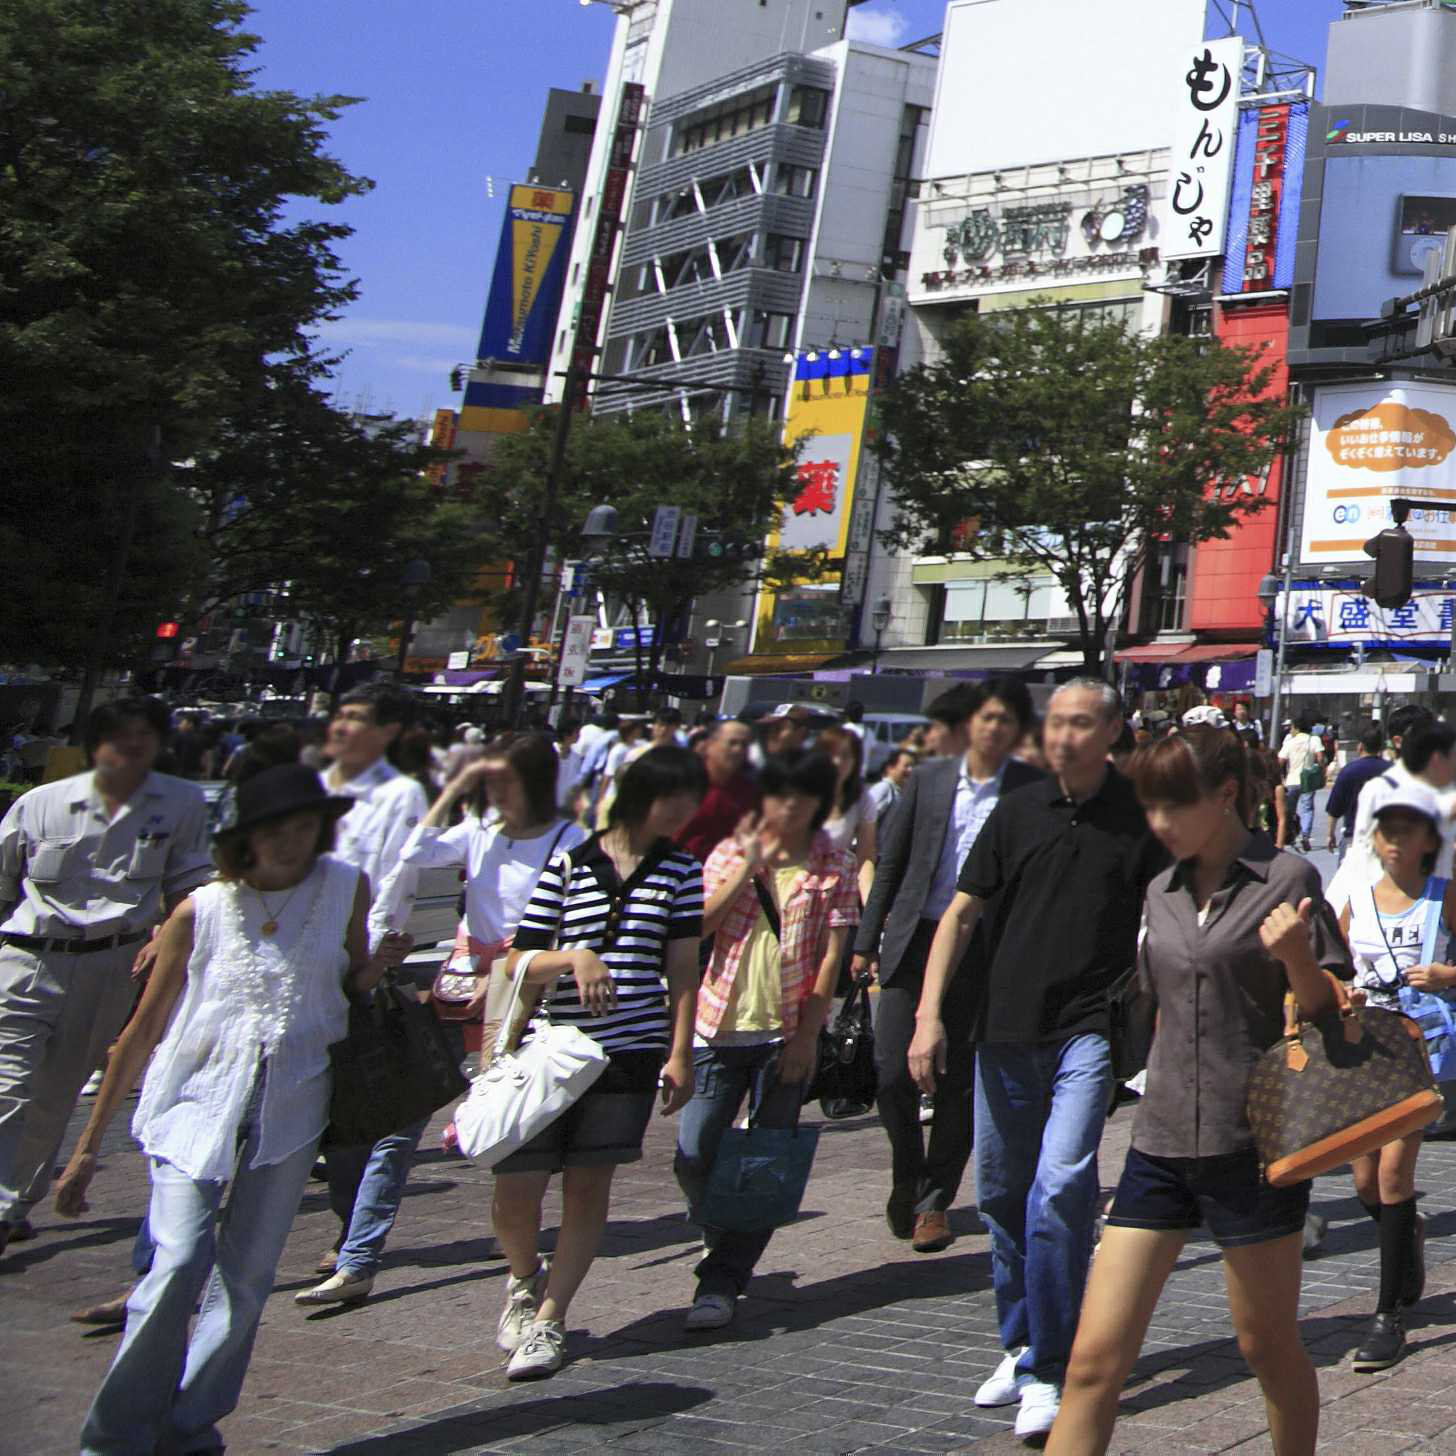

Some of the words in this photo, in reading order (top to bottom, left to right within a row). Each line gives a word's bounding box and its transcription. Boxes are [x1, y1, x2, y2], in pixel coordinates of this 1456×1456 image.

[1172, 48, 1231, 247] もんじゃ
[1345, 131, 1396, 144] SUPER
[1398, 131, 1433, 143] LISA
